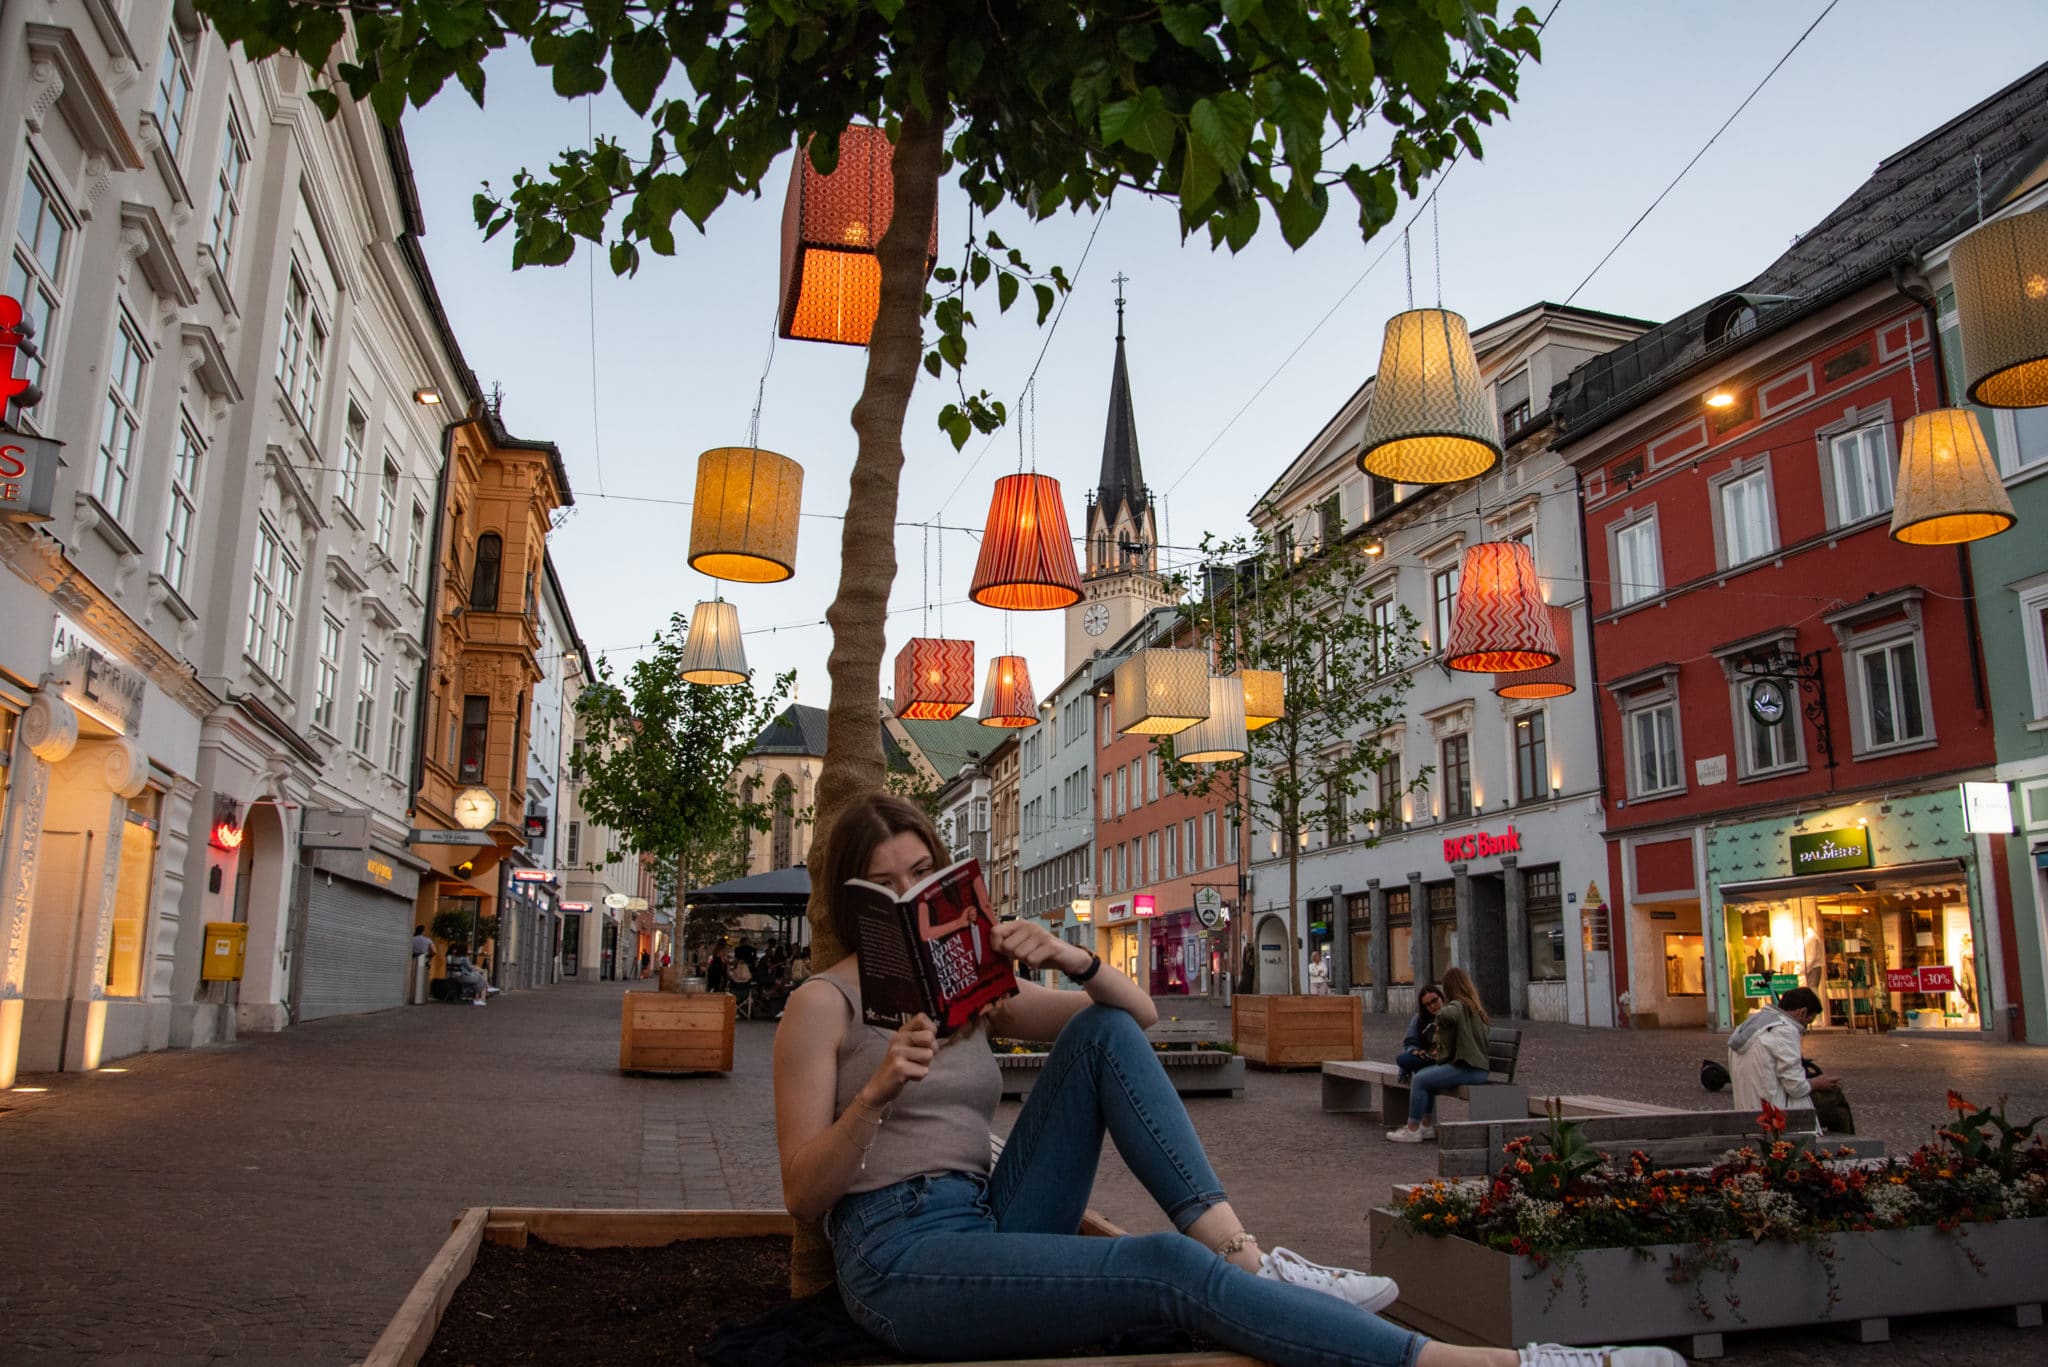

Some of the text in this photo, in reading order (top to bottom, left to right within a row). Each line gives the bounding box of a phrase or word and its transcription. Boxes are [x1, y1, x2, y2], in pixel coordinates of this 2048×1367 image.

[55, 627, 146, 704] ANTEPRIMA
[1443, 825, 1521, 862] BKS Bank
[1800, 845, 1862, 862] PALMERS
[928, 937, 940, 952] IN
[932, 944, 965, 971] MANN
[937, 950, 974, 982] STECKT
[940, 964, 974, 989] ETWAS
[942, 972, 978, 1001] GUTES
[1888, 973, 1912, 981] Palmers
[1888, 980, 1917, 988] Club Sale
[1923, 973, 1951, 985] -30%
